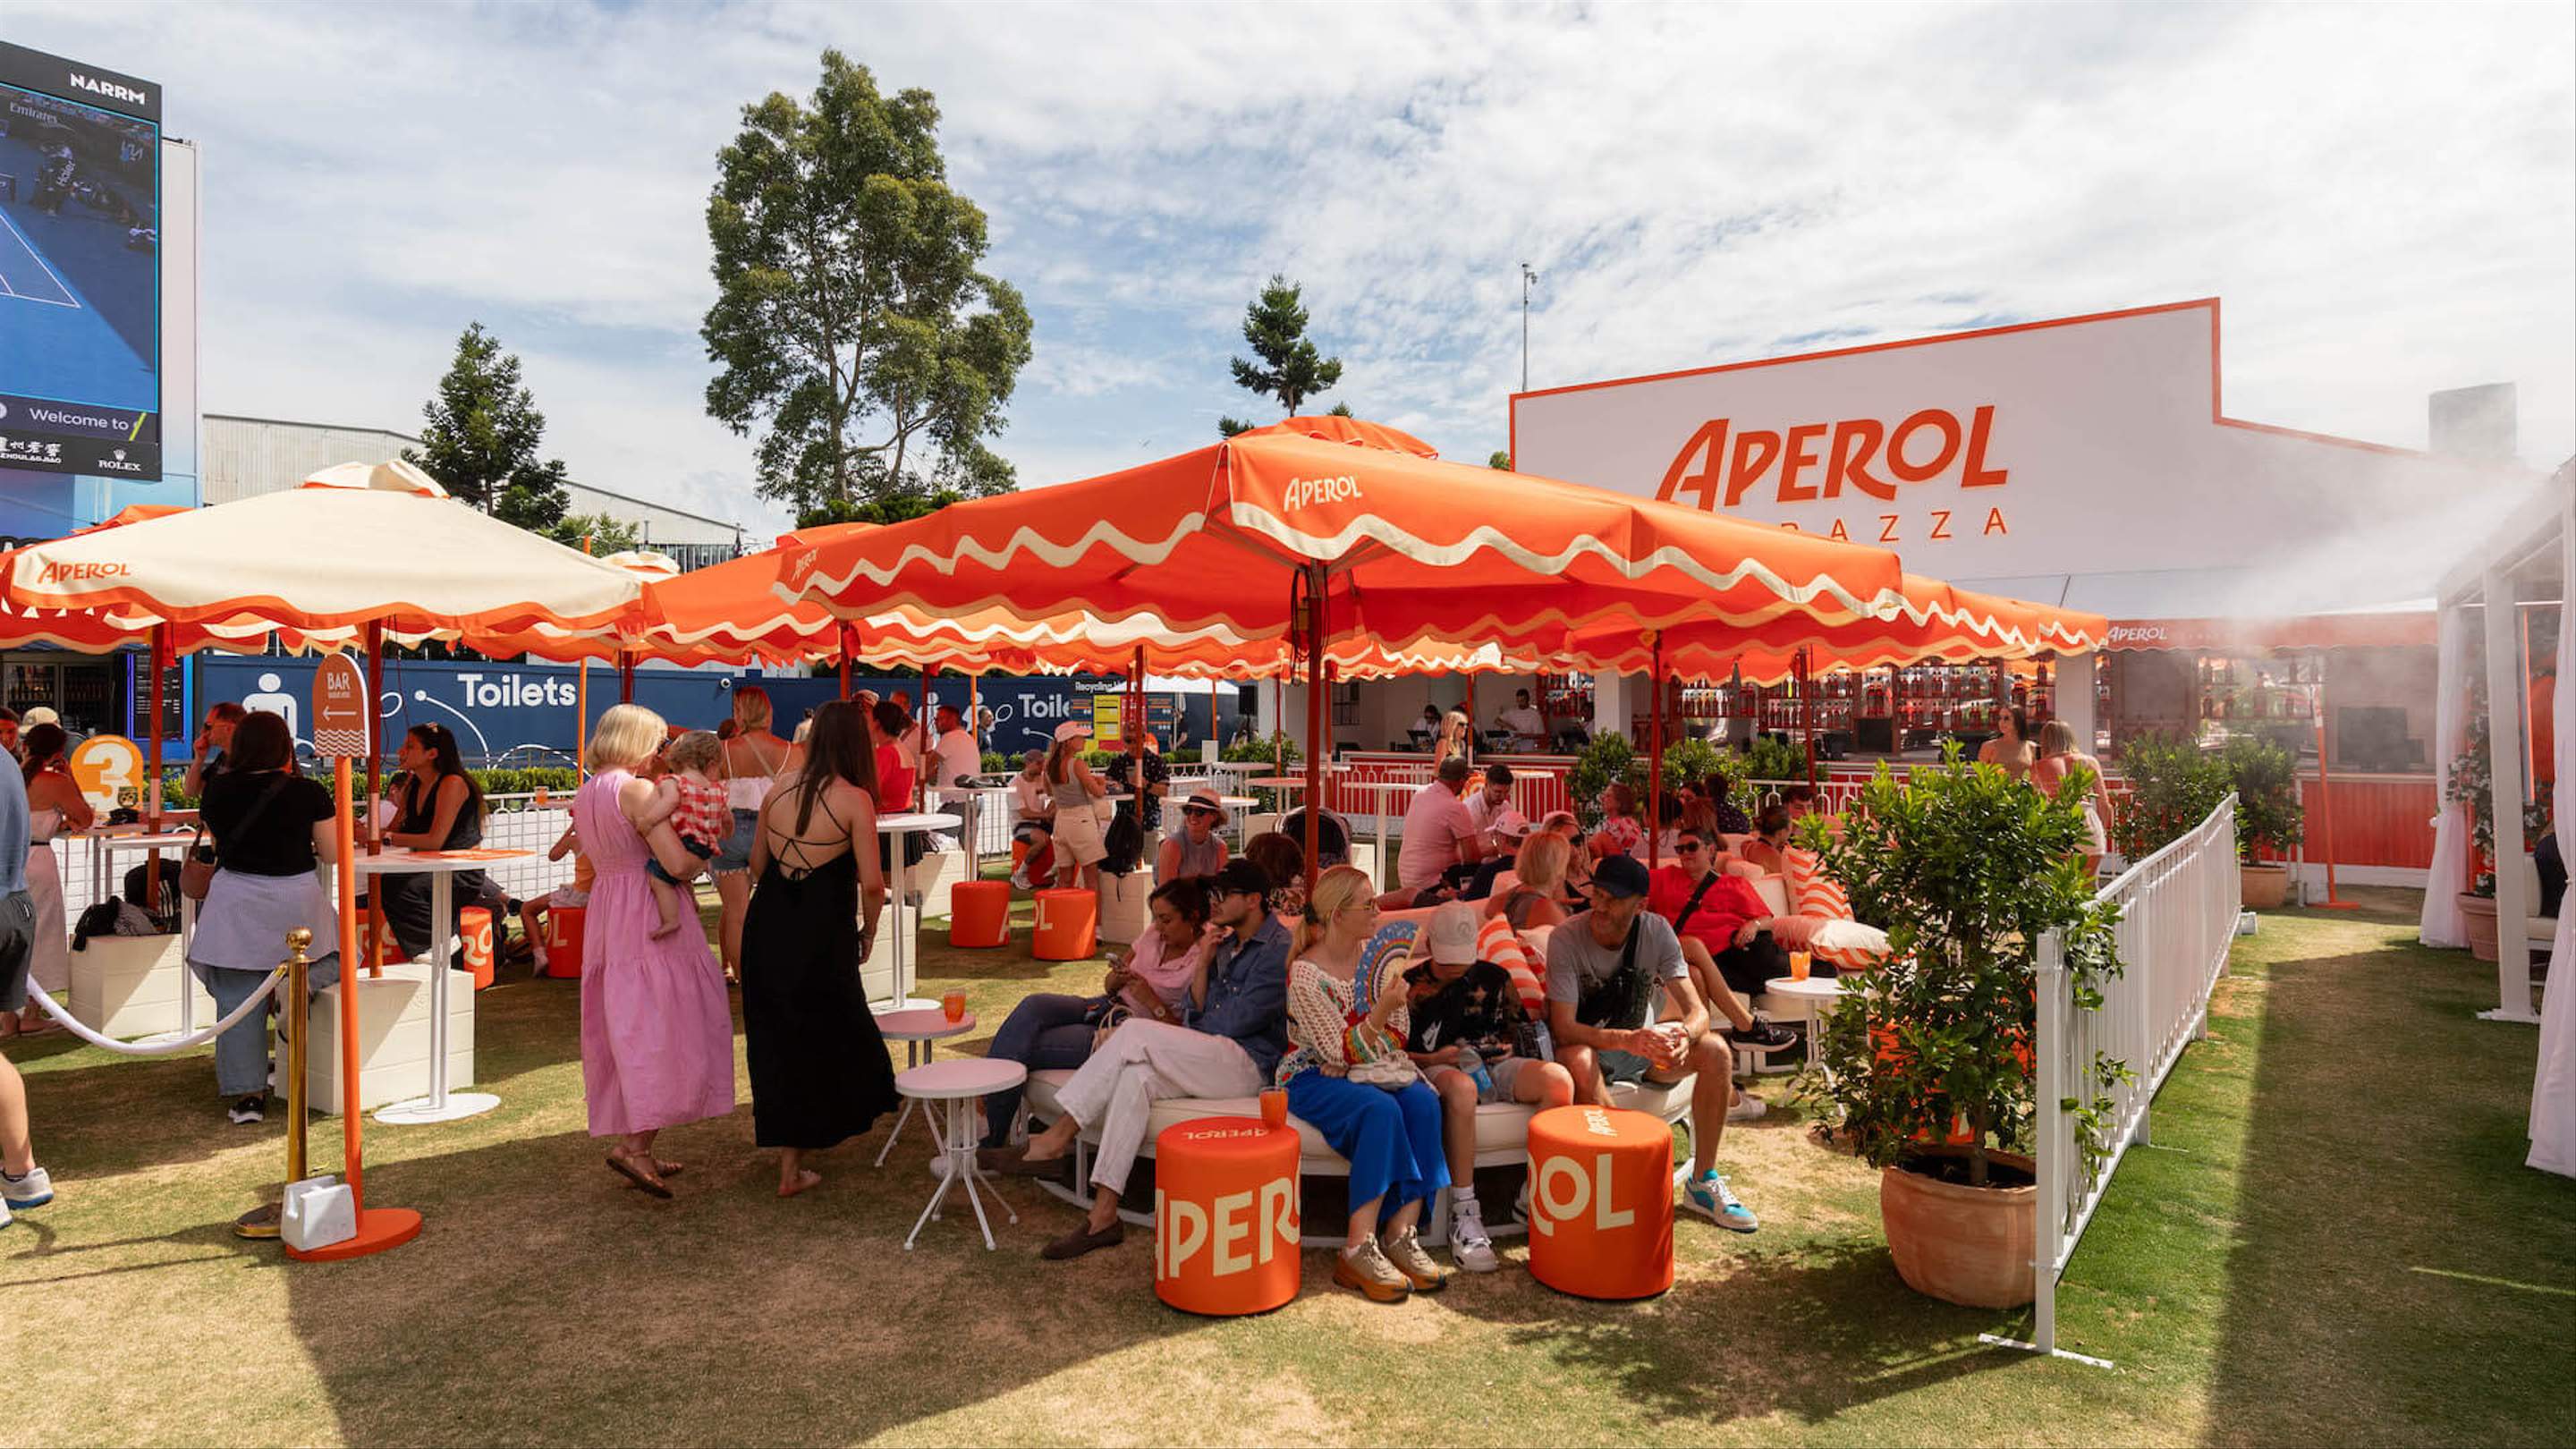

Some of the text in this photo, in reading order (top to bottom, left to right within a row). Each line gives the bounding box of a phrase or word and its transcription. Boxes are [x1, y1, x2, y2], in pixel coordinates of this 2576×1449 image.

[70, 72, 146, 106] NARRM
[10, 101, 58, 124] Emirates
[30, 407, 108, 429] Welcome
[112, 418, 130, 431] to
[97, 459, 142, 472] ROLEX
[1655, 405, 2008, 513] APEROL
[1284, 475, 1363, 513] APEROL
[1780, 507, 2007, 542] AZZA
[37, 560, 131, 584] APEROL
[2107, 626, 2168, 642] APEROL
[326, 672, 351, 691] BAR
[457, 674, 577, 708] Toilets
[84, 743, 133, 811] 3
[1156, 1157, 1301, 1282] PER
